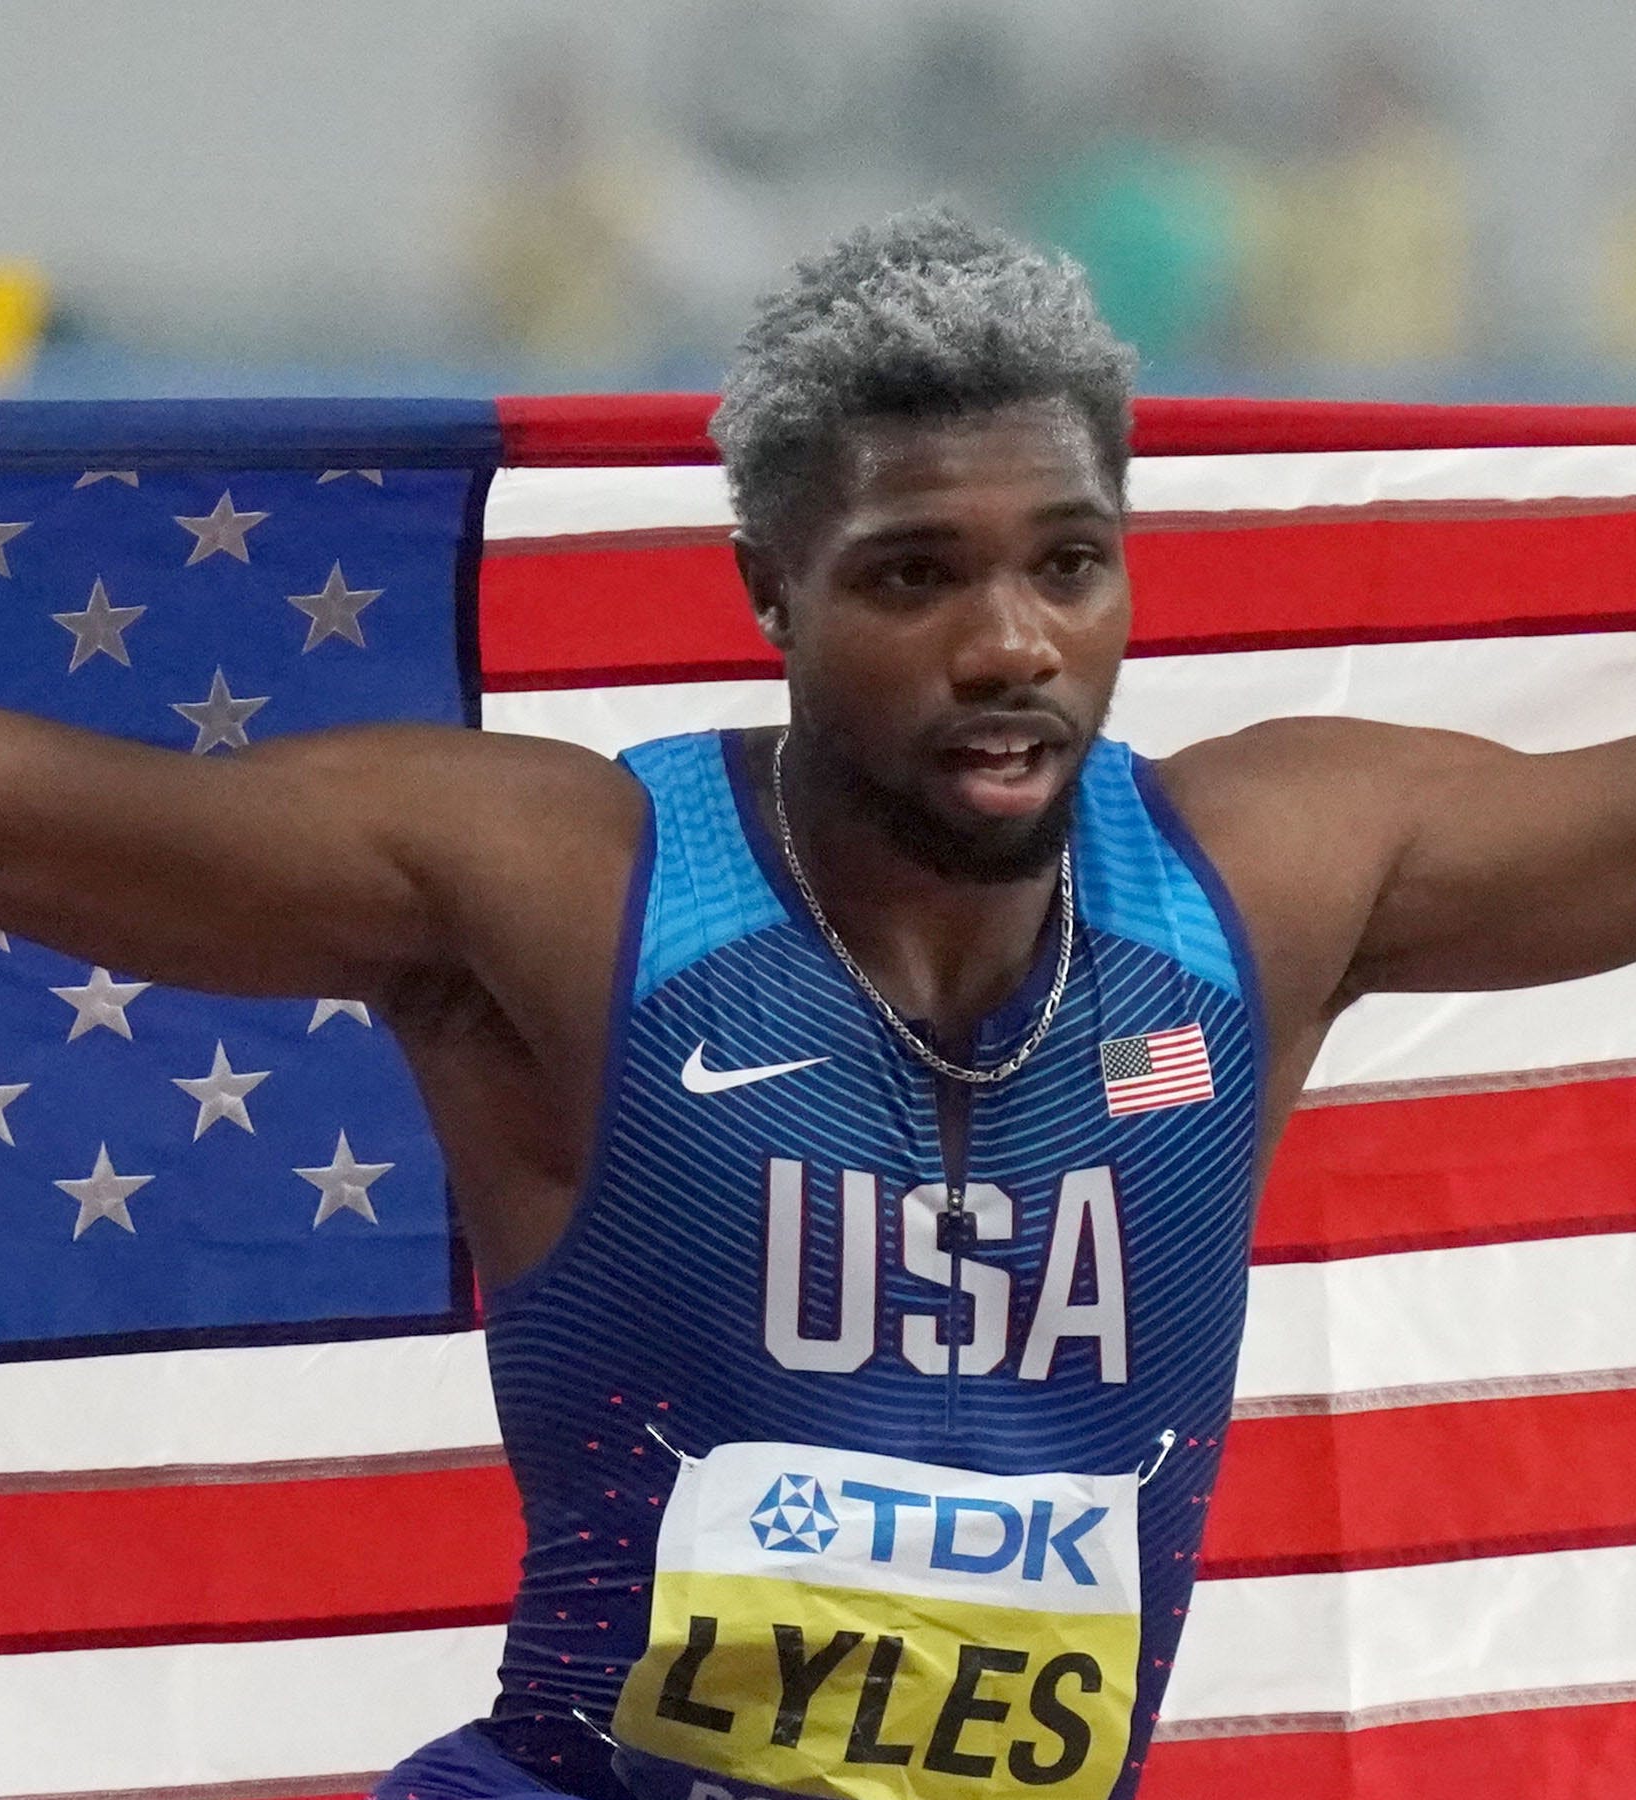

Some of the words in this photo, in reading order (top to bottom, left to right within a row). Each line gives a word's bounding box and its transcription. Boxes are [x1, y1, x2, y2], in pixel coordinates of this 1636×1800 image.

[763, 1156, 1127, 1386] USA
[840, 1479, 1110, 1587] TDK
[656, 1615, 1103, 1787] LYLES
